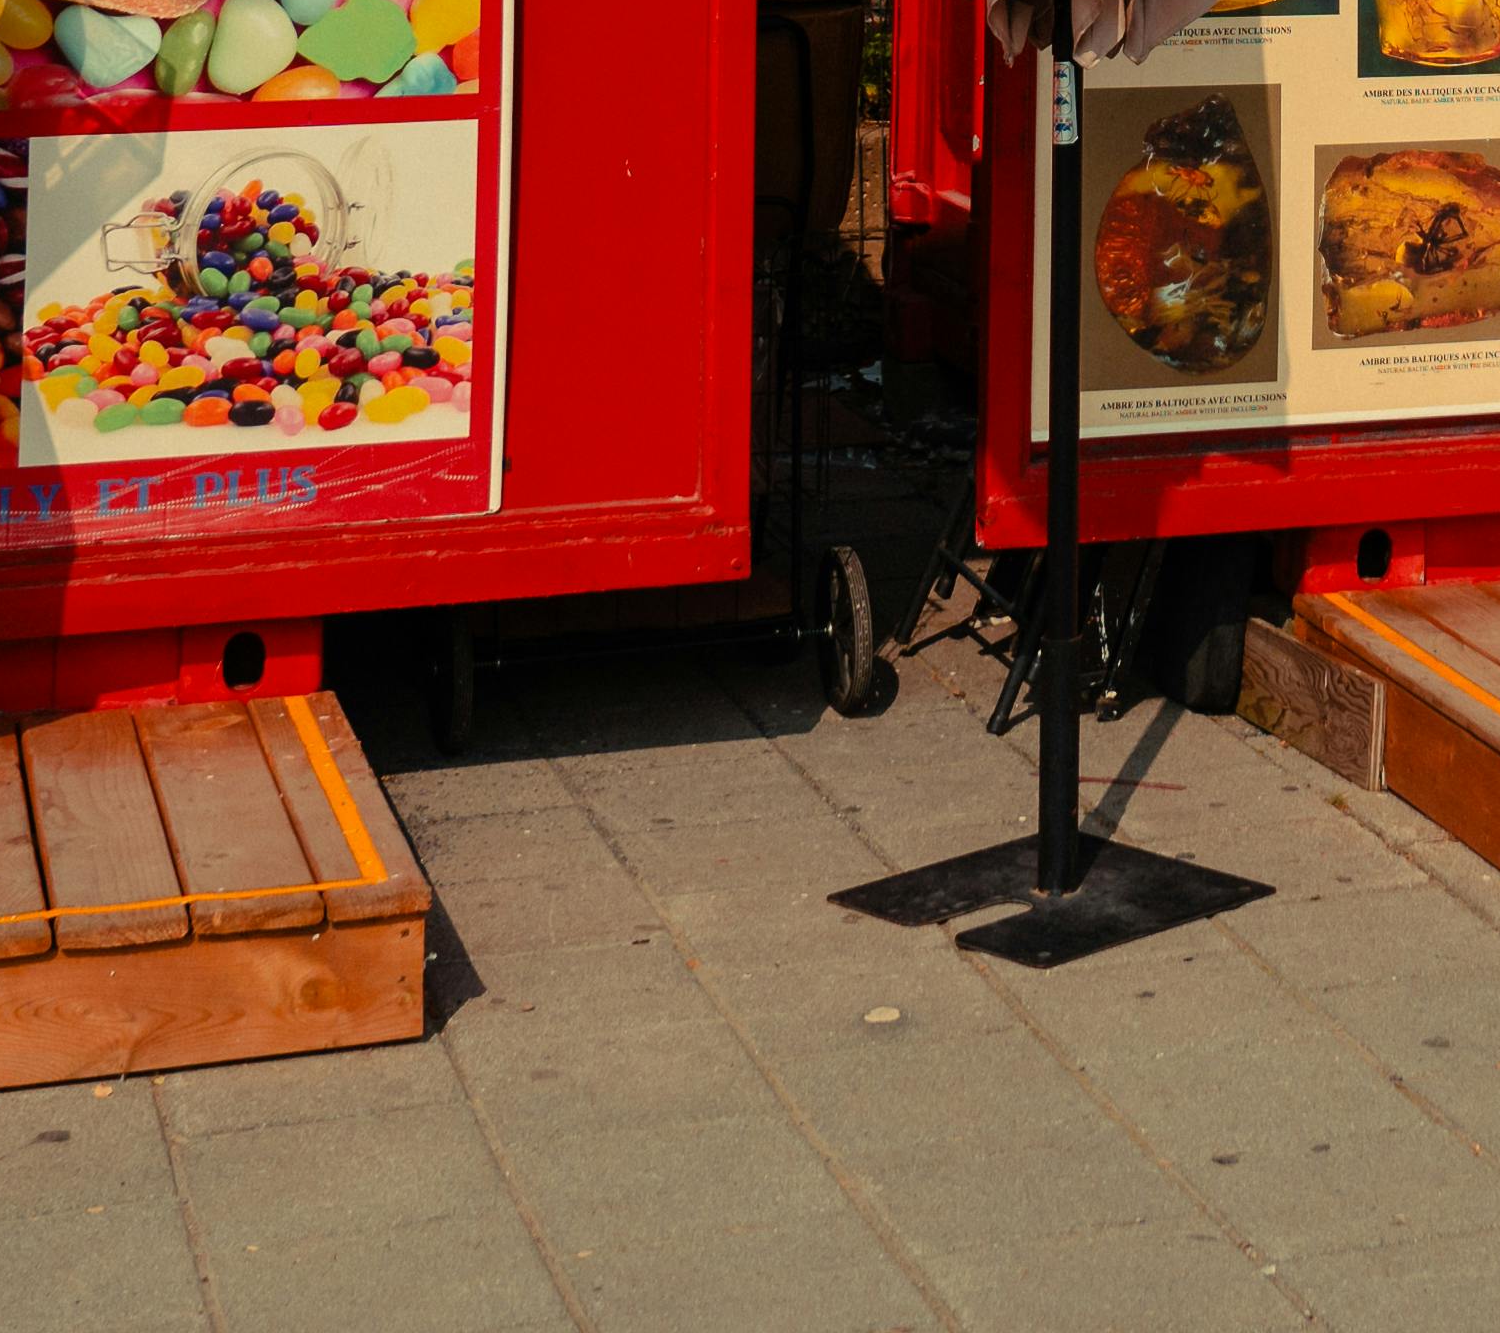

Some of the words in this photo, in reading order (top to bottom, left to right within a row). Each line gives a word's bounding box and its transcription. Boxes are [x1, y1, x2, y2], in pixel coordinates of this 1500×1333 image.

[1213, 27, 1237, 36] AVEC
[1238, 26, 1292, 36] INCLUSIONS
[1363, 89, 1395, 98] AMBRE
[1396, 89, 1413, 97] DES
[1415, 87, 1462, 97] BALTIQUES
[1463, 86, 1486, 95] AVEC
[1359, 357, 1391, 366] AMBRE
[1393, 356, 1410, 364] DES
[1411, 353, 1459, 363] BALTIQUES
[1460, 352, 1483, 361] AVEC
[1100, 401, 1134, 411] AMBRE
[1135, 400, 1153, 409] DES
[1155, 397, 1206, 408] BALTIQUES
[1207, 395, 1231, 405] AVEC
[1233, 393, 1287, 404] INCLUSIONS
[96, 475, 162, 519] ET
[193, 464, 318, 511] PLUS
